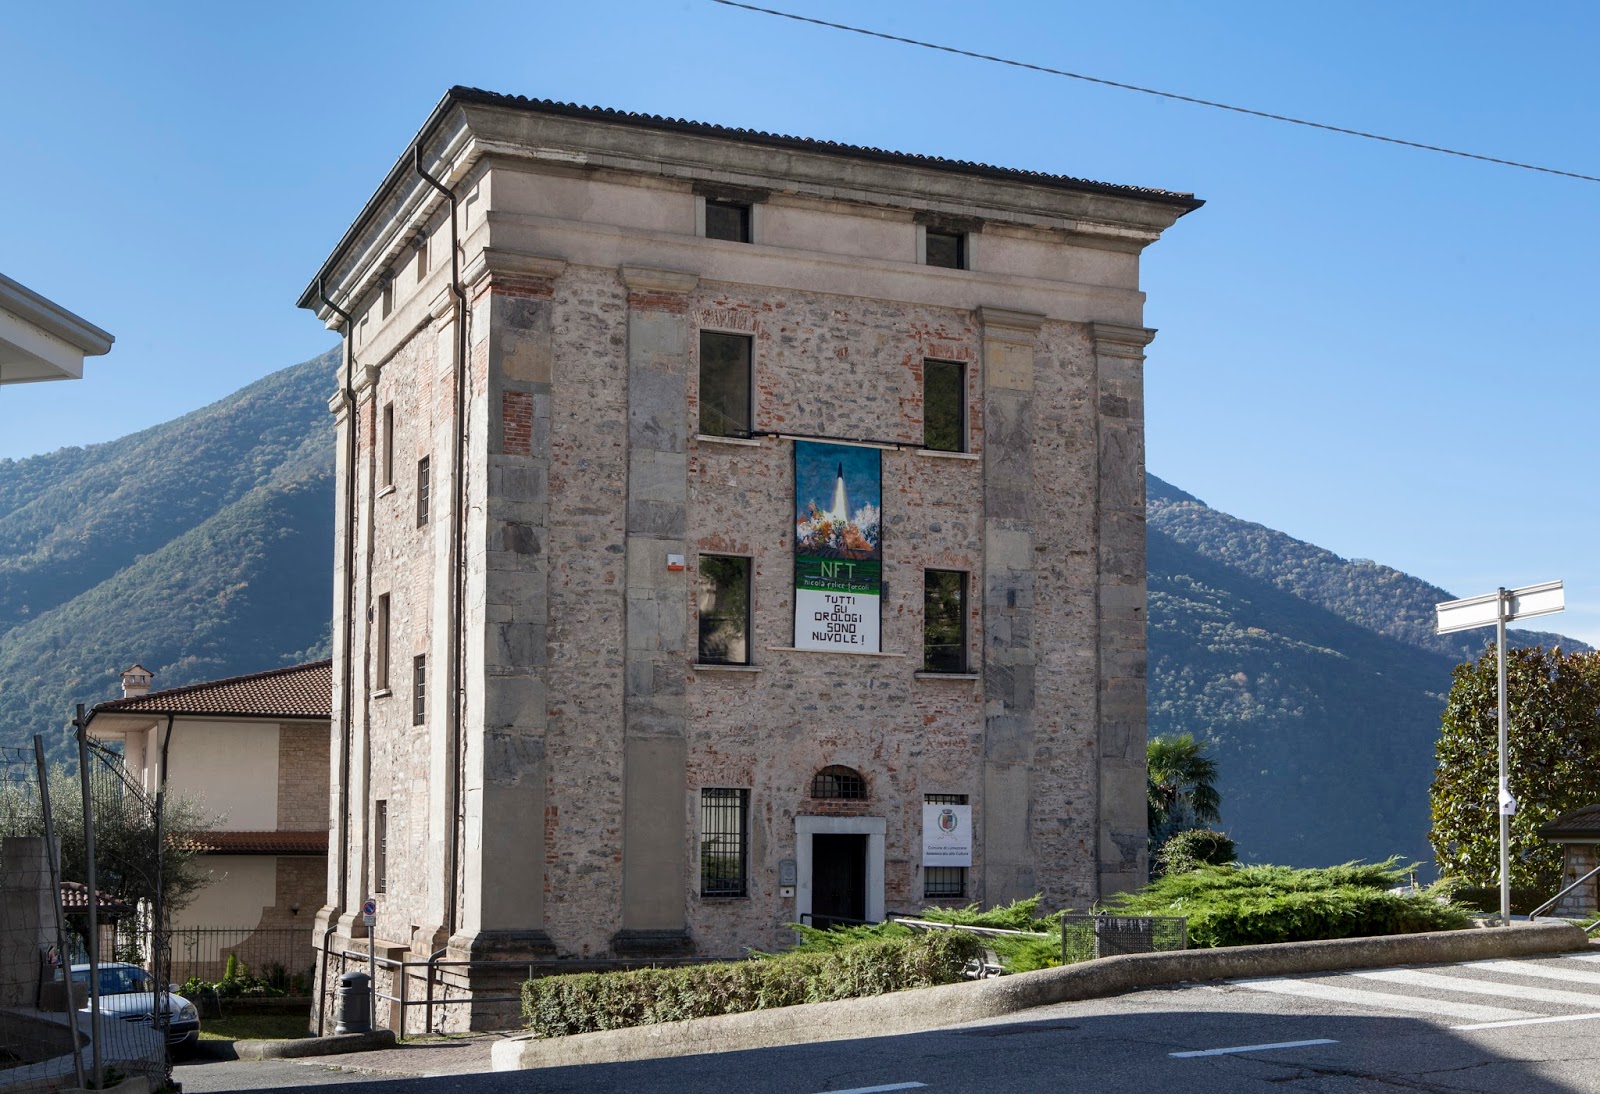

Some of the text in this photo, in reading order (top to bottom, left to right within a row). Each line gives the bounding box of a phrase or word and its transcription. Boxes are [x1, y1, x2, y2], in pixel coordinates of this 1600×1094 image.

[821, 561, 857, 579] NFT
[825, 594, 855, 605] TUTTI
[834, 604, 848, 614] GLI
[814, 611, 862, 623] OROLOGI
[827, 622, 856, 634] SONO
